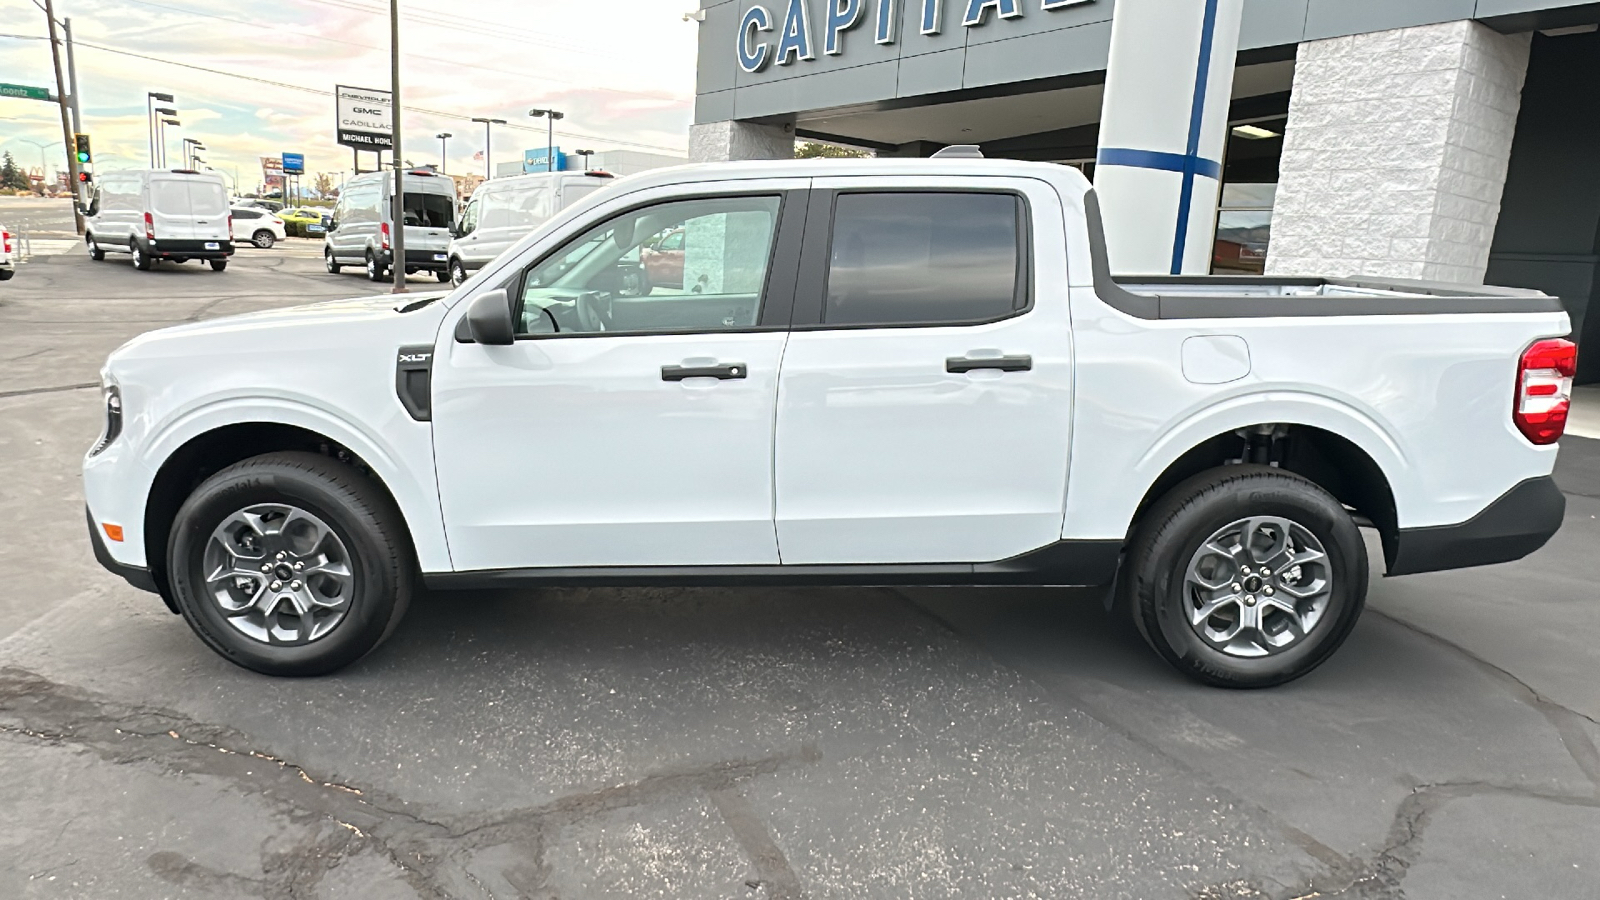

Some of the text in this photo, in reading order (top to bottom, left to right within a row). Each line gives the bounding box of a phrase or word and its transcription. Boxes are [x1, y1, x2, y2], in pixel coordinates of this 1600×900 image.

[736, 0, 1096, 72] CAPI
[353, 106, 382, 116] GMC
[342, 119, 392, 130] CADILLAC
[342, 133, 373, 144] MICHAEL
[399, 353, 431, 362] XLT
